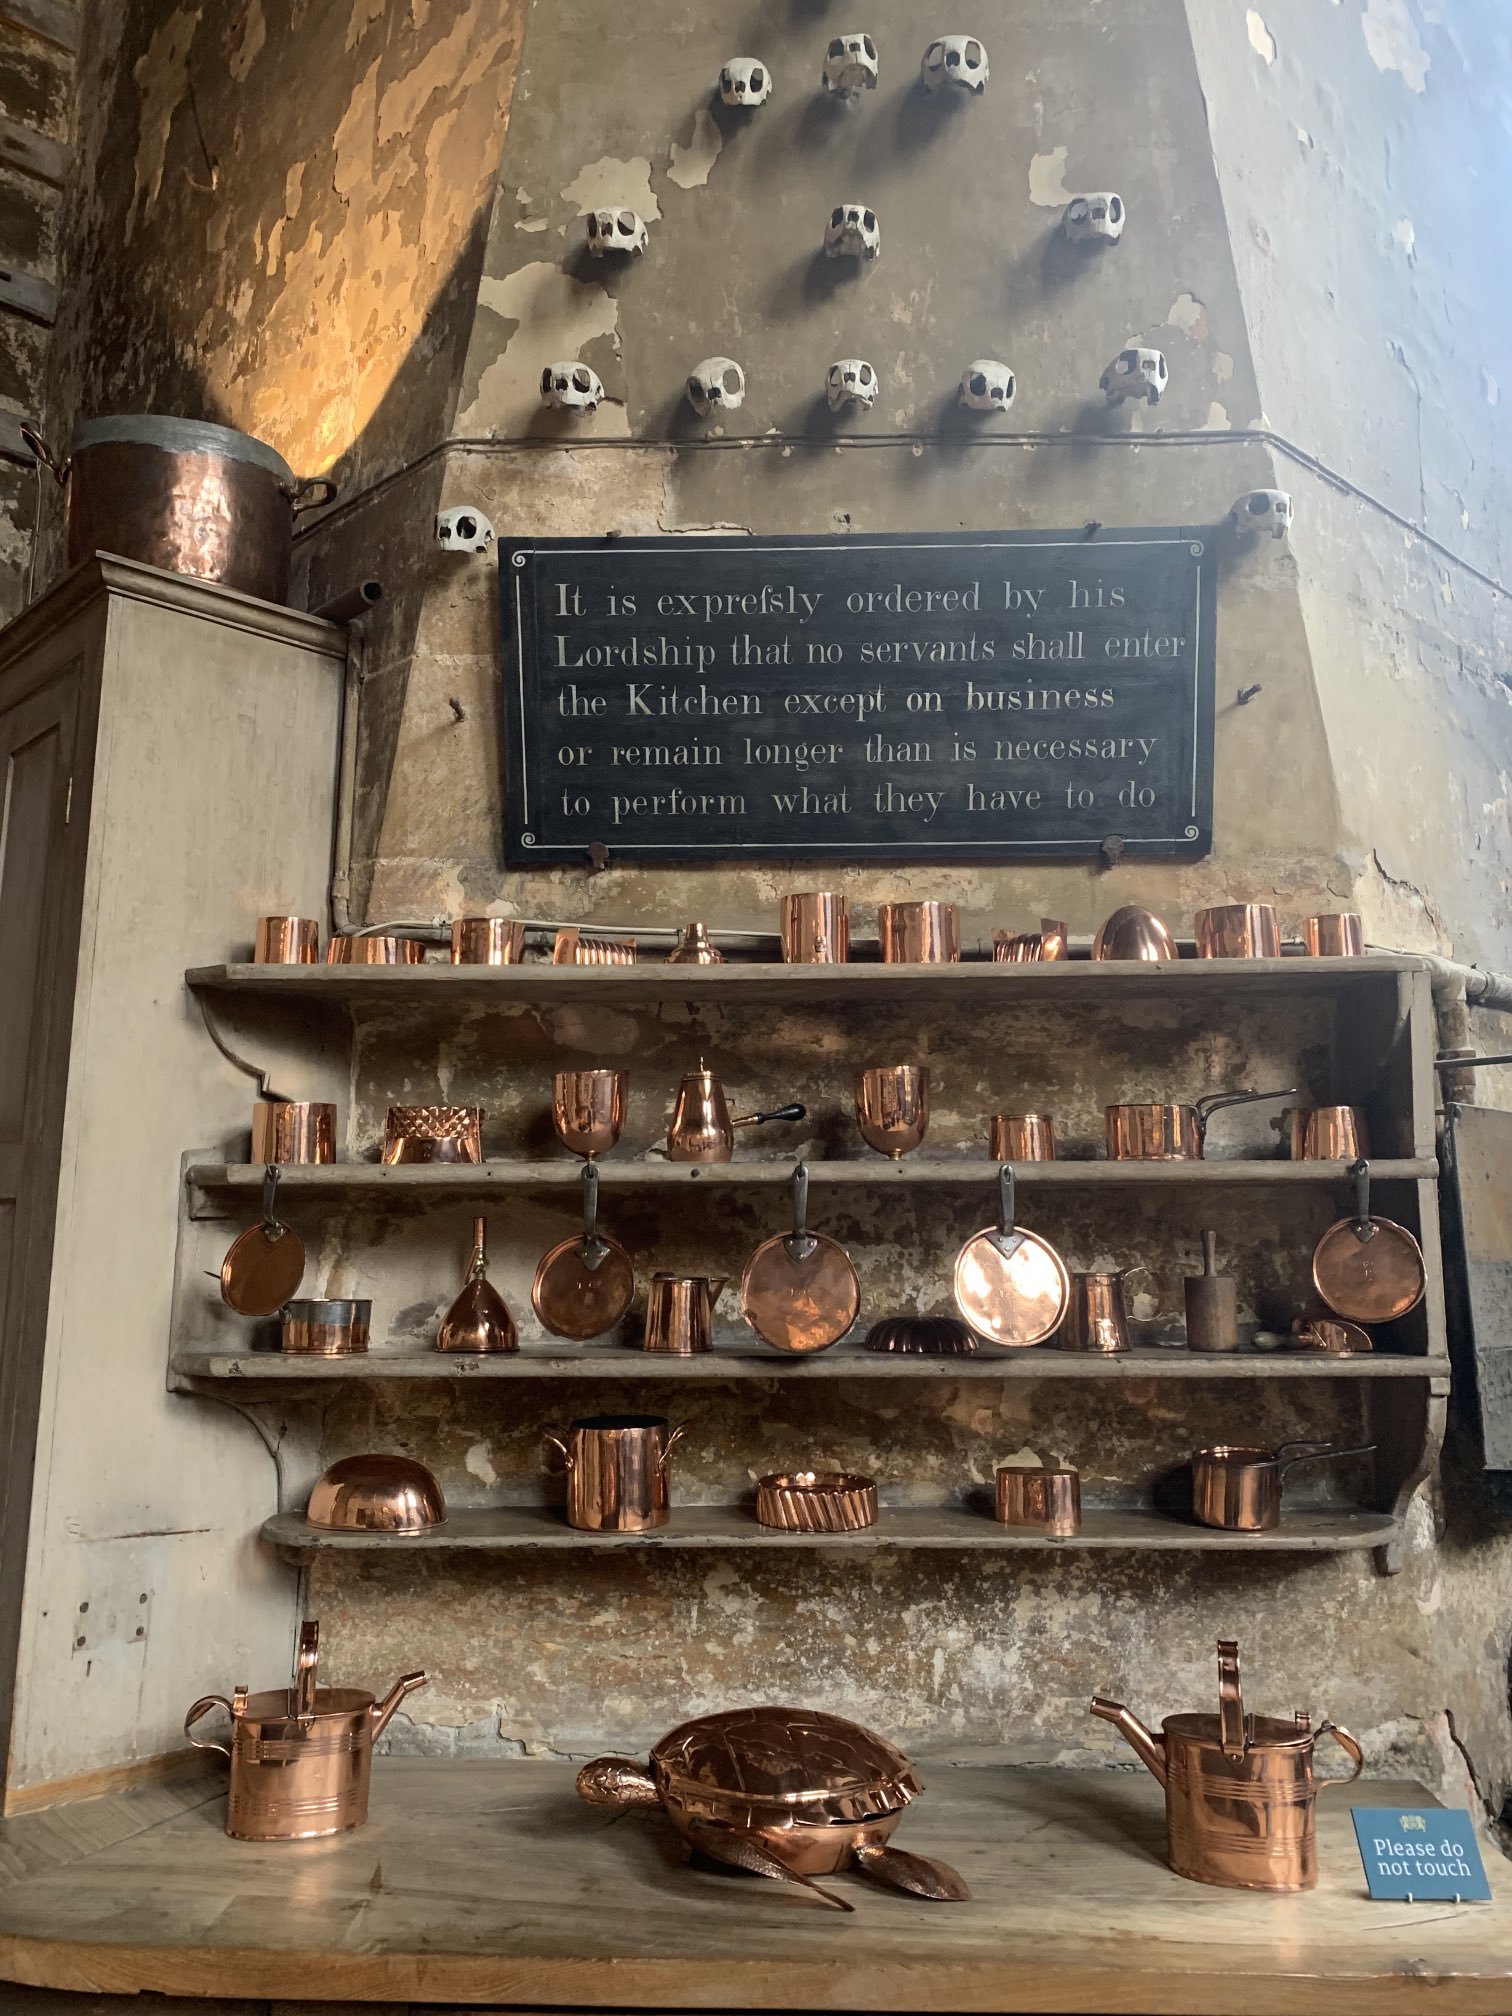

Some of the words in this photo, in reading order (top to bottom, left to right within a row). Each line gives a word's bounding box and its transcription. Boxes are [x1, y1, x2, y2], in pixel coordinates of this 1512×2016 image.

[554, 583, 586, 616] It
[606, 585, 637, 616] is
[846, 582, 982, 613] ordered
[1003, 581, 1046, 618] by
[1068, 579, 1125, 608] his
[553, 635, 716, 674] Lordship
[729, 634, 794, 665] that
[806, 643, 843, 664] no
[860, 632, 995, 663] servants
[1012, 631, 1085, 660] shall
[1104, 628, 1186, 658] enter
[557, 684, 607, 716] the
[625, 683, 763, 716] Kitchen
[784, 683, 887, 722] except
[906, 691, 943, 713] on
[966, 678, 1115, 712] business
[558, 746, 593, 766] or
[611, 737, 723, 766] remain
[744, 738, 843, 772] longer
[864, 734, 932, 763] than
[953, 732, 977, 762] is
[994, 737, 1158, 765] necessary
[561, 788, 590, 816] to
[612, 788, 747, 825] perform
[772, 785, 852, 815] what
[874, 783, 946, 823] they
[966, 784, 1041, 811] have
[1065, 781, 1094, 809] to
[1118, 781, 1156, 808] do
[1373, 1839, 1436, 1857] Please
[1441, 1839, 1464, 1857] do
[1378, 1860, 1411, 1876] not
[1416, 1859, 1471, 1876] touch
